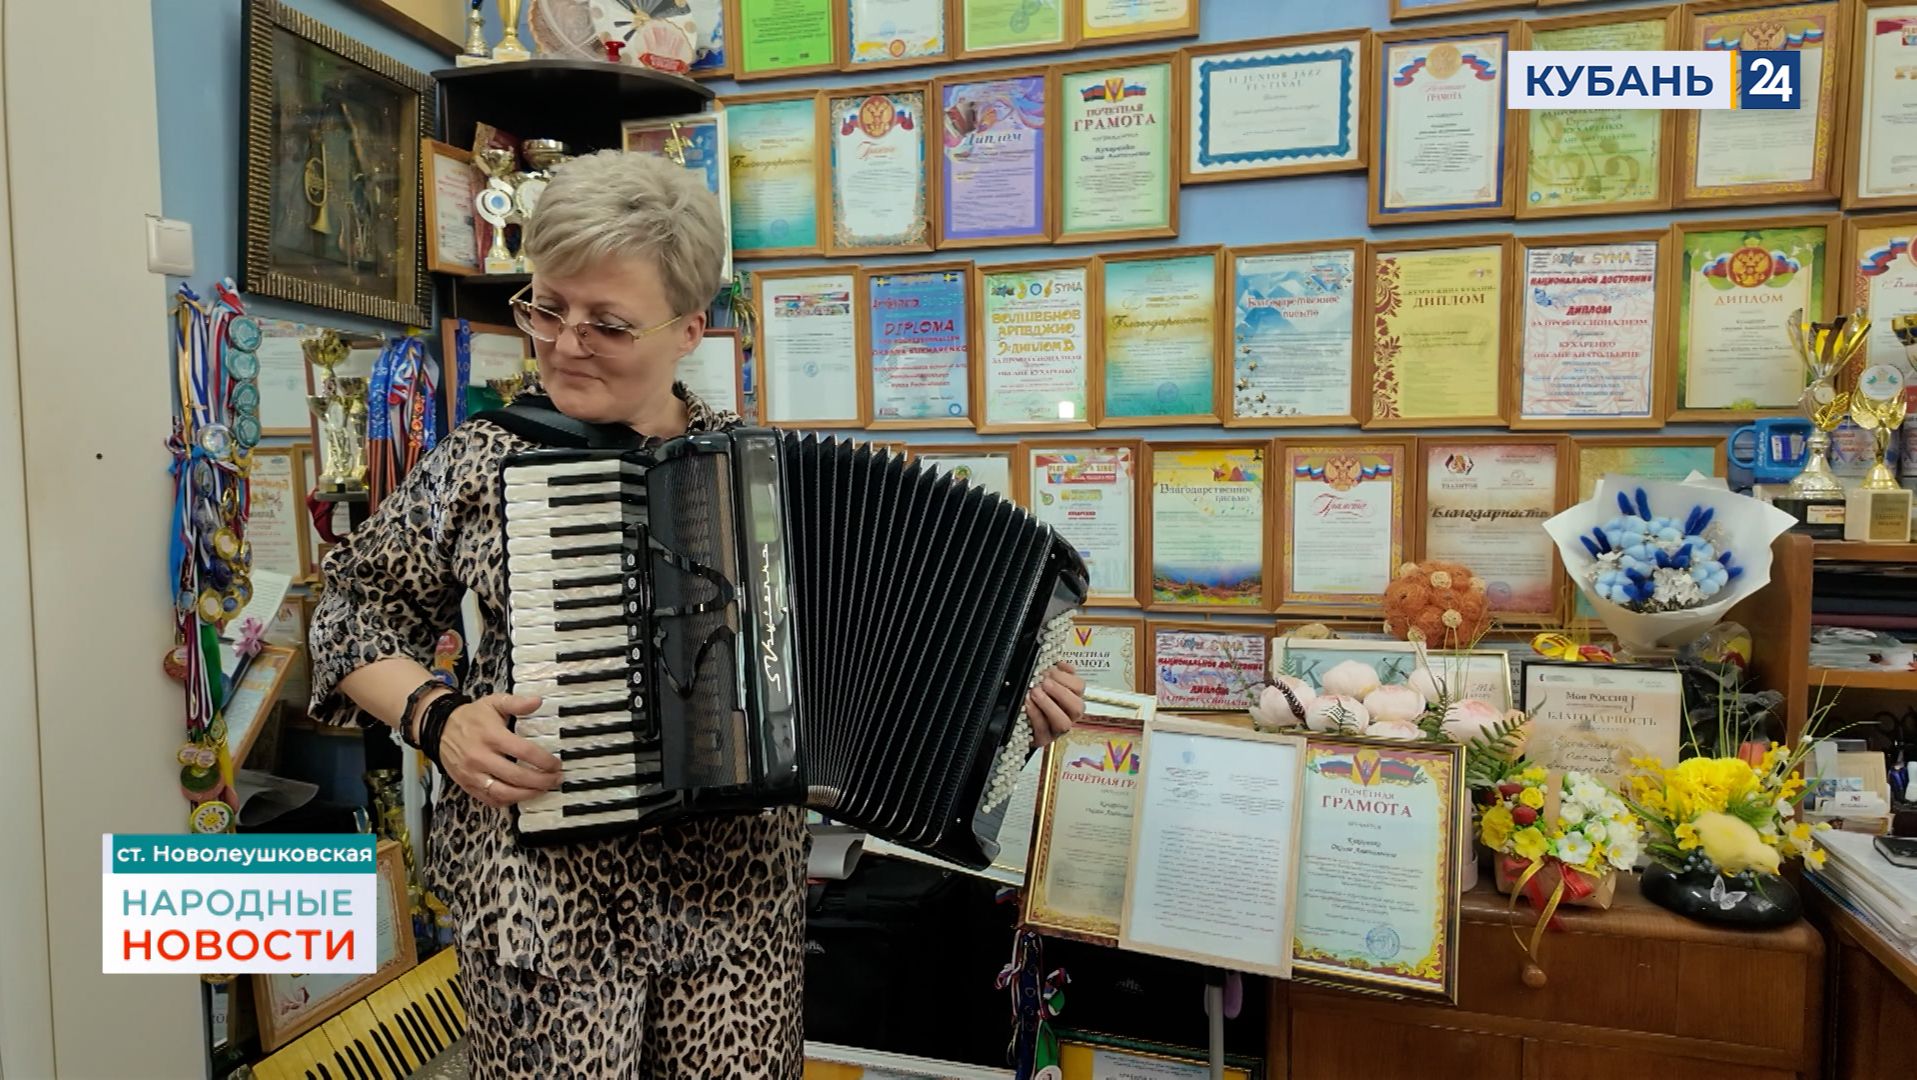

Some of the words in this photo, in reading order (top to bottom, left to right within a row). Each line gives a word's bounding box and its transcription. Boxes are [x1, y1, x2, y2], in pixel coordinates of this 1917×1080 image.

[1073, 113, 1156, 132] ГРАМОТА
[1413, 293, 1485, 308] ДИПЛОМ
[1714, 294, 1784, 306] ДИПЛОМ
[1566, 305, 1612, 316] ДИПЛОМ
[884, 319, 954, 336] DIPLOMA
[1322, 795, 1413, 818] ГРАМОТА
